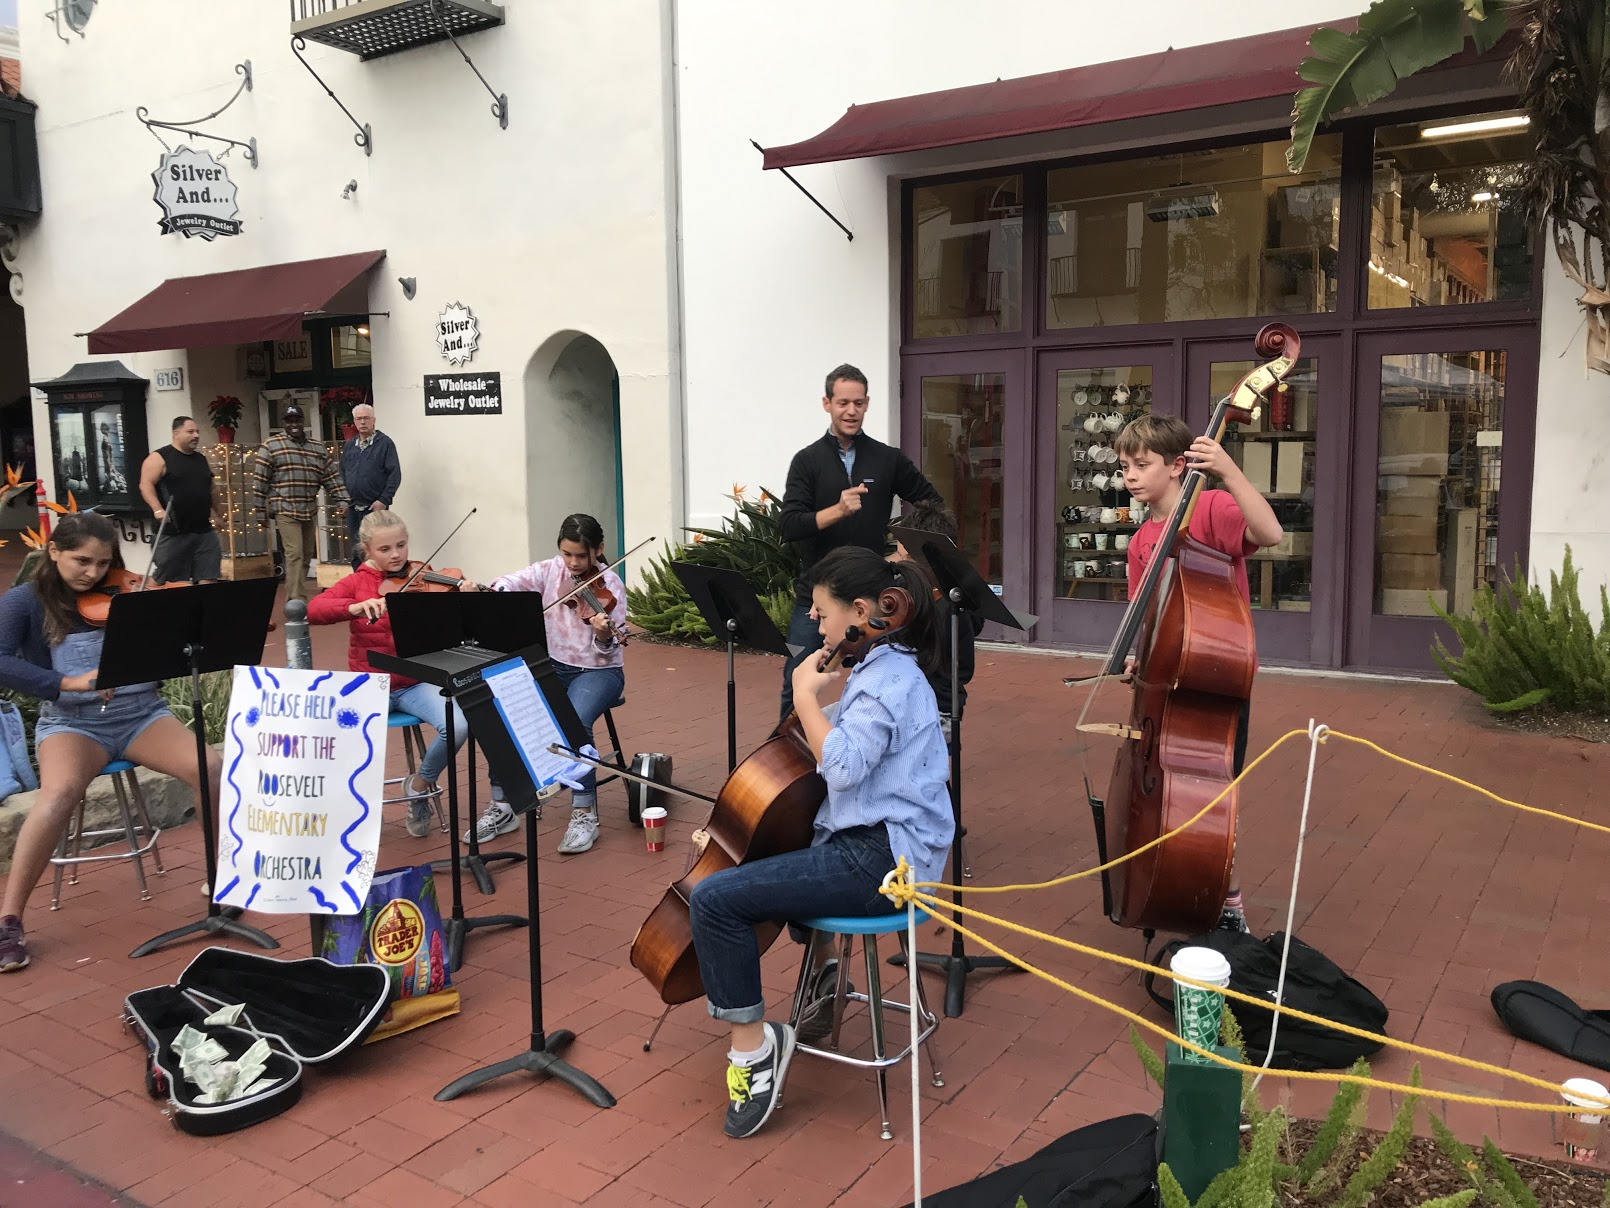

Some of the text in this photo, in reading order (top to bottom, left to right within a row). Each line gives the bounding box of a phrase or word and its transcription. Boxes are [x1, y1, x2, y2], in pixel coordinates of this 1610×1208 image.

[170, 163, 222, 182] Silver
[176, 186, 229, 203] And...
[176, 217, 234, 232] Jewelry Outlet
[440, 319, 470, 335] Silver
[277, 341, 308, 359] SALE
[443, 335, 473, 352] And...
[156, 371, 179, 387] 616
[438, 377, 487, 392] Wholesale
[428, 394, 499, 411] Jewelry Outlet
[260, 689, 337, 720] PLEASE HELP
[257, 731, 337, 761] SUPPORT THE
[257, 769, 325, 798] ROOSEVELT
[247, 803, 328, 837] ELEMENTARY
[254, 850, 322, 881] ORCHESTRA
[377, 925, 419, 948] TRADER
[383, 938, 415, 957] JOE'S
[417, 957, 429, 991] JOSE
